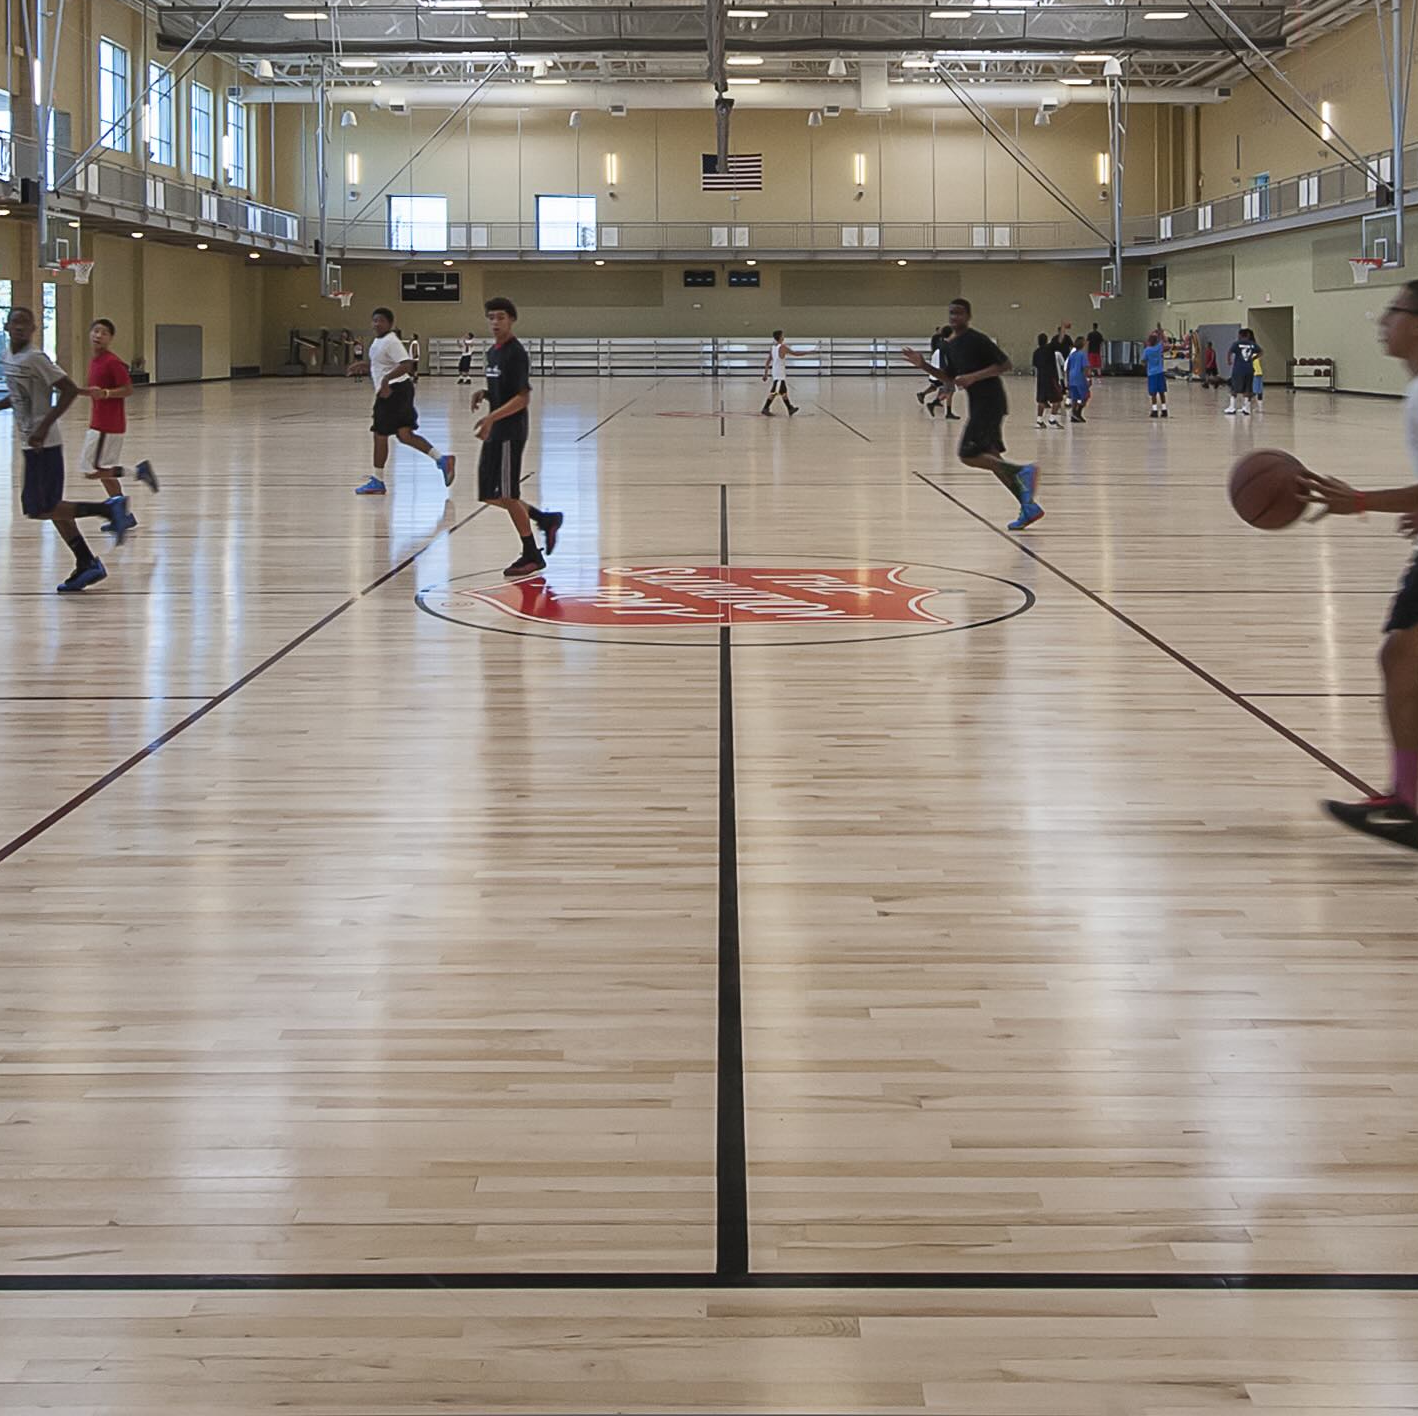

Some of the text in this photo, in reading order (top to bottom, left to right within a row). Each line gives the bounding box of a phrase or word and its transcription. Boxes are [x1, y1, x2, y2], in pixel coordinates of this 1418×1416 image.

[530, 583, 725, 619] ARMY
[600, 566, 875, 620] SALVATION
[750, 572, 896, 597] THE
